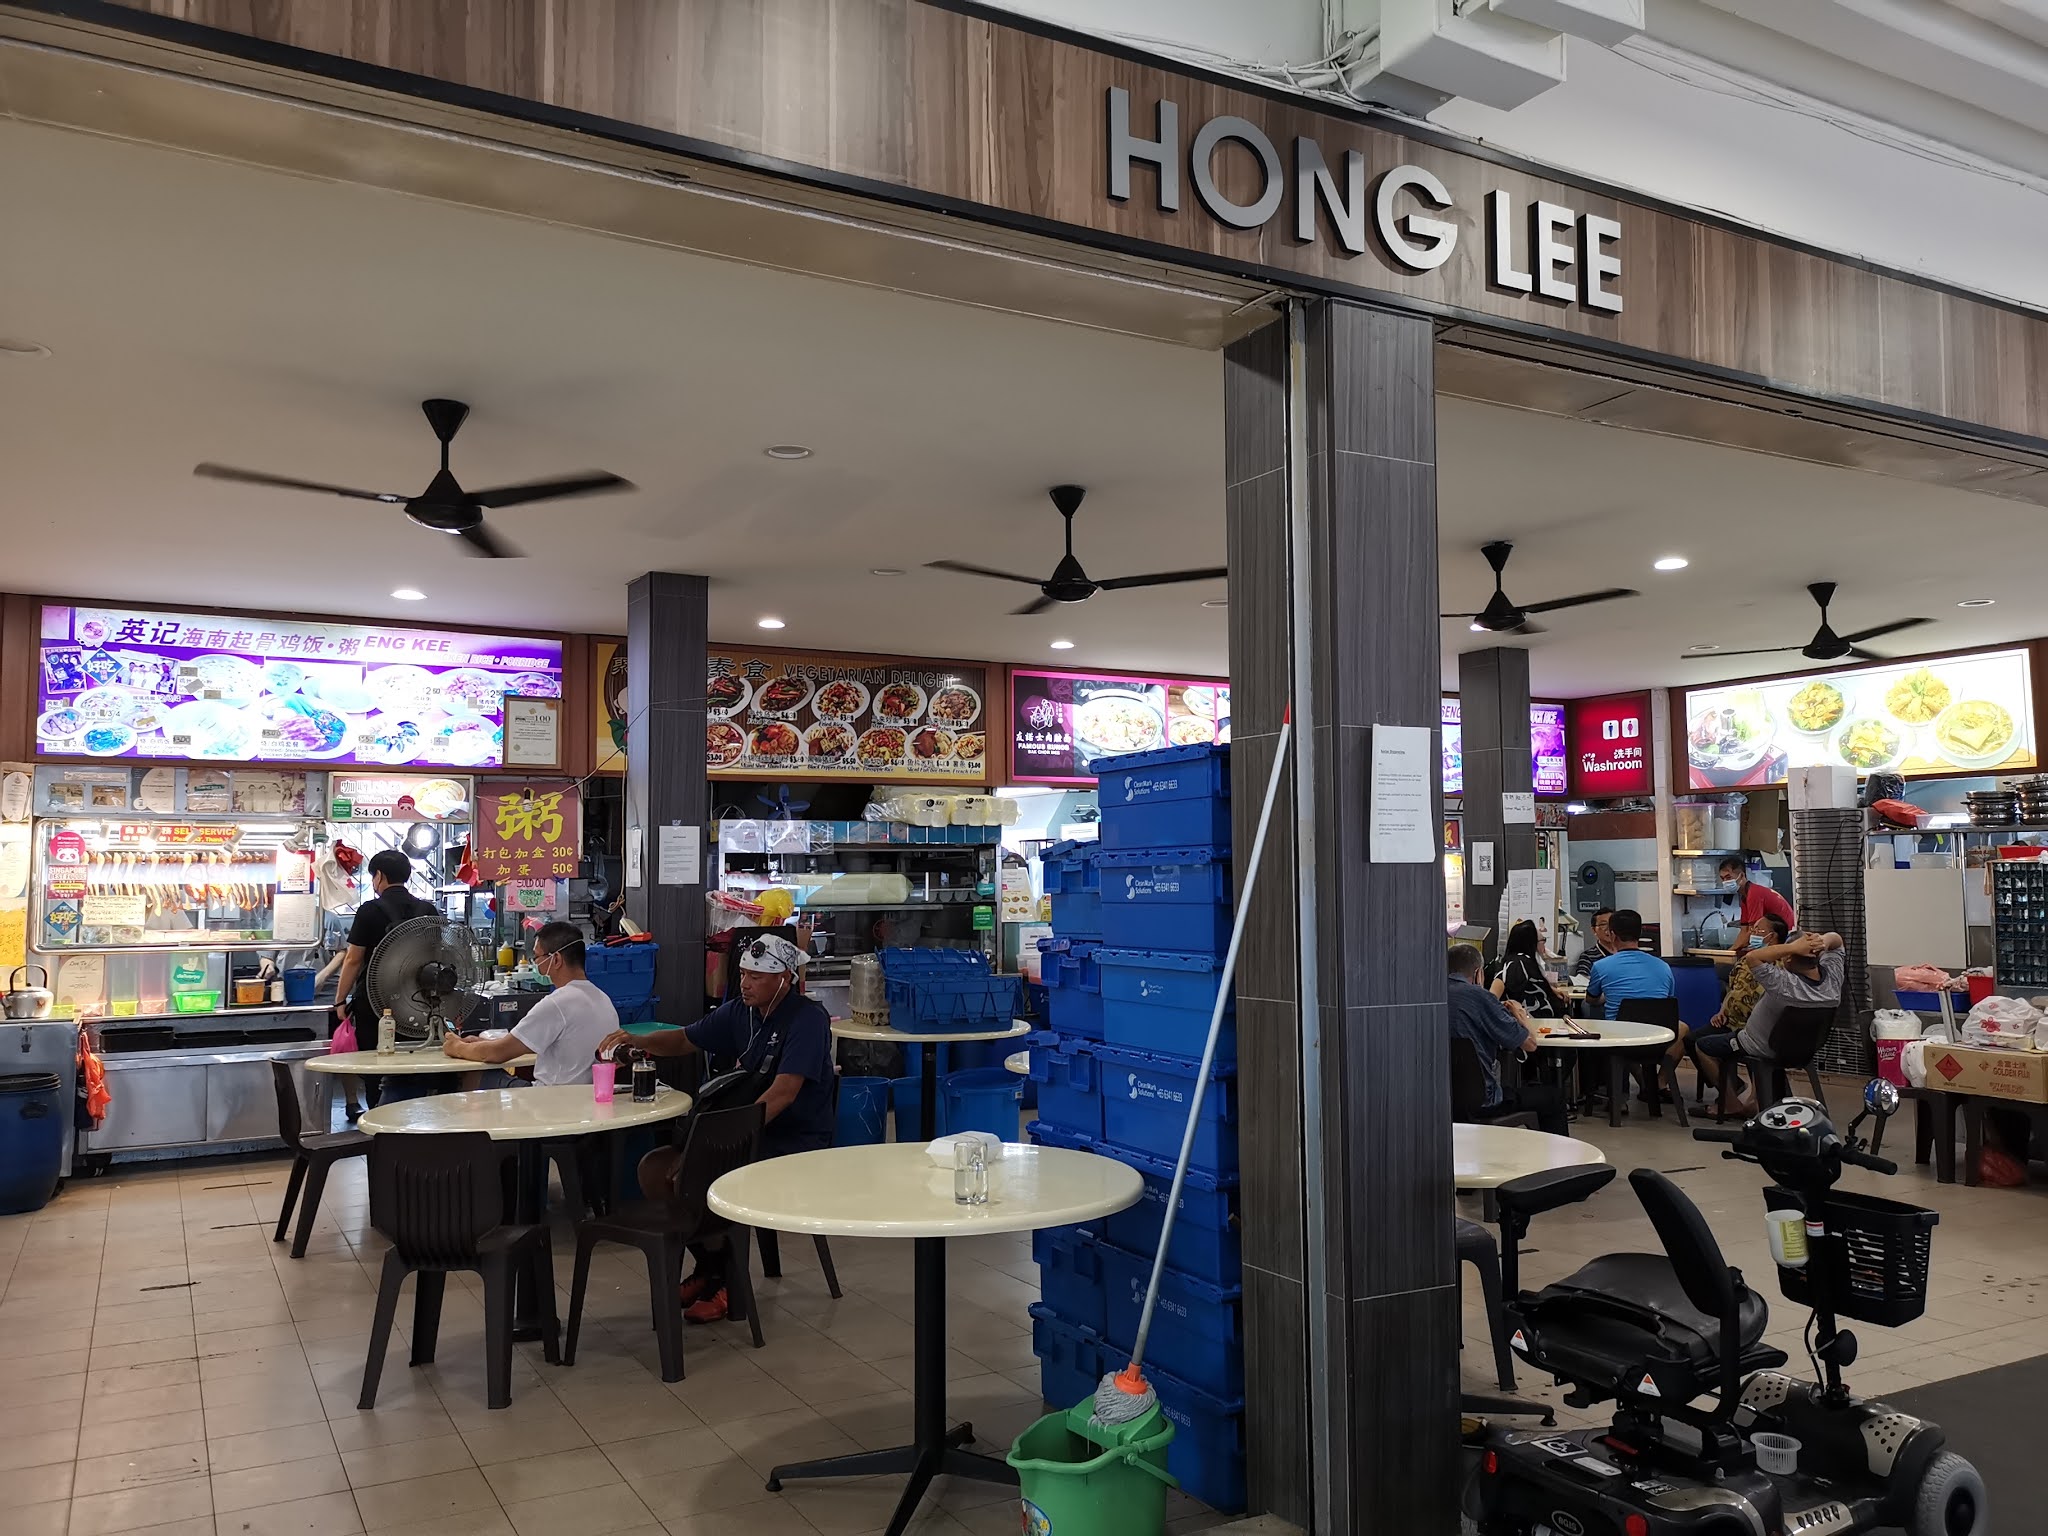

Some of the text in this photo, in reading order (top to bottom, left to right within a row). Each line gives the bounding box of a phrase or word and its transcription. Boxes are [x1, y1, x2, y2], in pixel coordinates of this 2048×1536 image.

[1107, 86, 1623, 314] HONG LEE
[114, 617, 181, 647] 英记
[364, 635, 406, 650] ENG
[411, 639, 452, 653] KEE
[470, 653, 495, 665] RICE
[499, 655, 550, 668] PORRIDGE
[784, 663, 887, 684] VEGETARIAN
[890, 669, 955, 688] DELIGHT
[1018, 742, 1046, 750] FAMOUS
[1613, 747, 1643, 759] 洗手间
[1583, 757, 1643, 773] Washroom
[354, 806, 390, 817] $4.00
[495, 786, 564, 843] 粥
[125, 826, 172, 836] 自助务
[482, 846, 574, 860] 打包加盒 30¢
[496, 863, 574, 877] 加蛋 50¢
[1993, 1067, 2031, 1079] GOLDEN FUJI
